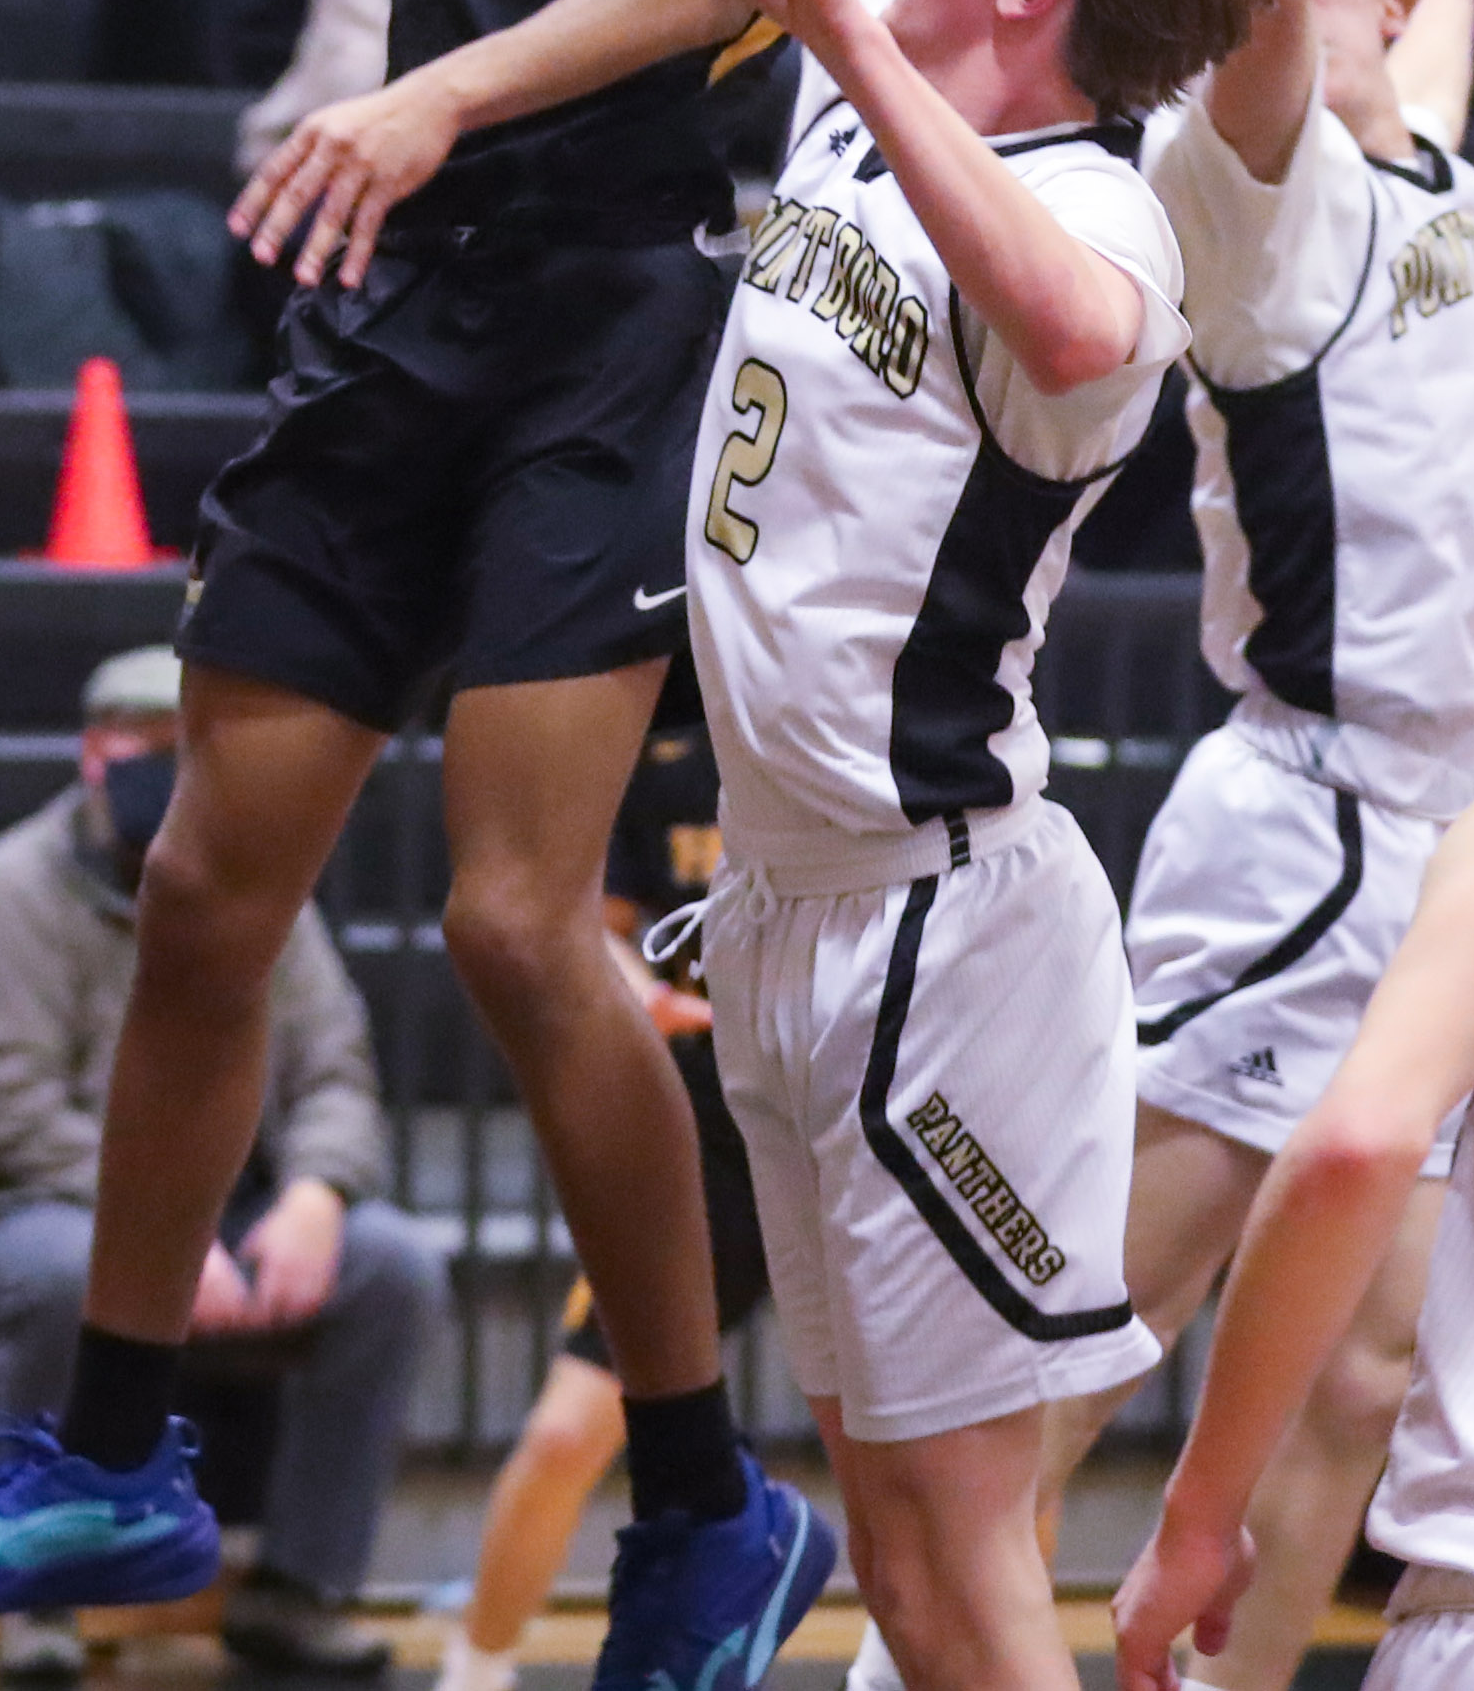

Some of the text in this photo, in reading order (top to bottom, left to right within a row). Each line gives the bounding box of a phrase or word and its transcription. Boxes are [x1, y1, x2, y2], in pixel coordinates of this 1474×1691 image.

[809, 221, 930, 401] BORO
[704, 357, 788, 566] 2
[905, 1089, 1067, 1287] PANTHERS
